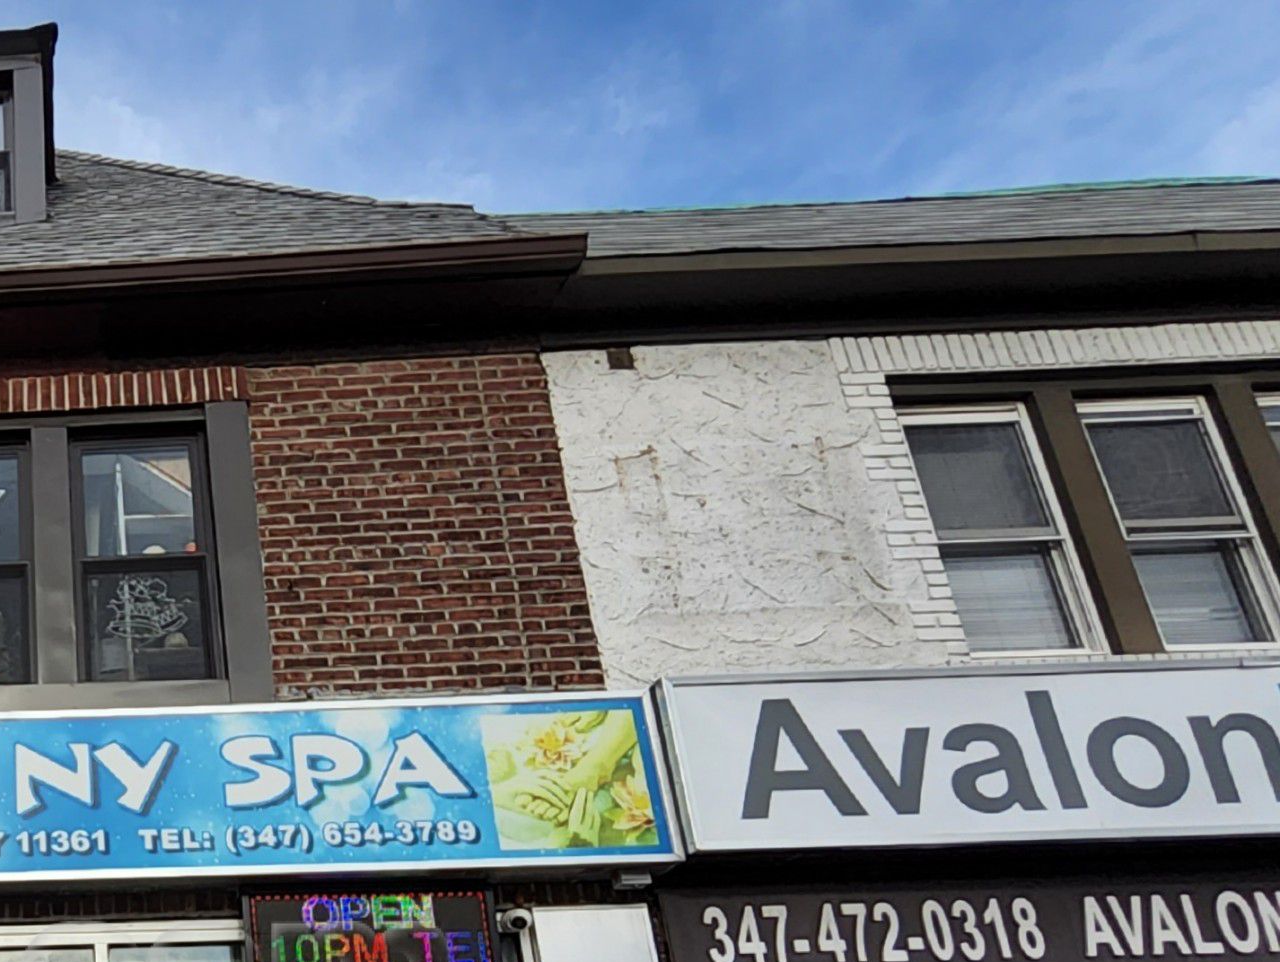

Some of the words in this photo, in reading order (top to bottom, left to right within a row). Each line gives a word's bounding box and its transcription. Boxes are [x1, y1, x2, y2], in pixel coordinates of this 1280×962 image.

[15, 740, 179, 818] NY
[221, 733, 474, 810] SPA
[741, 690, 1280, 820] Avalon
[16, 829, 110, 853] 11361
[138, 827, 215, 852] TEL:
[225, 824, 313, 855] (347)
[322, 820, 480, 846] 654-3789
[301, 894, 436, 931] OPEN
[1083, 890, 1280, 957] AVALON
